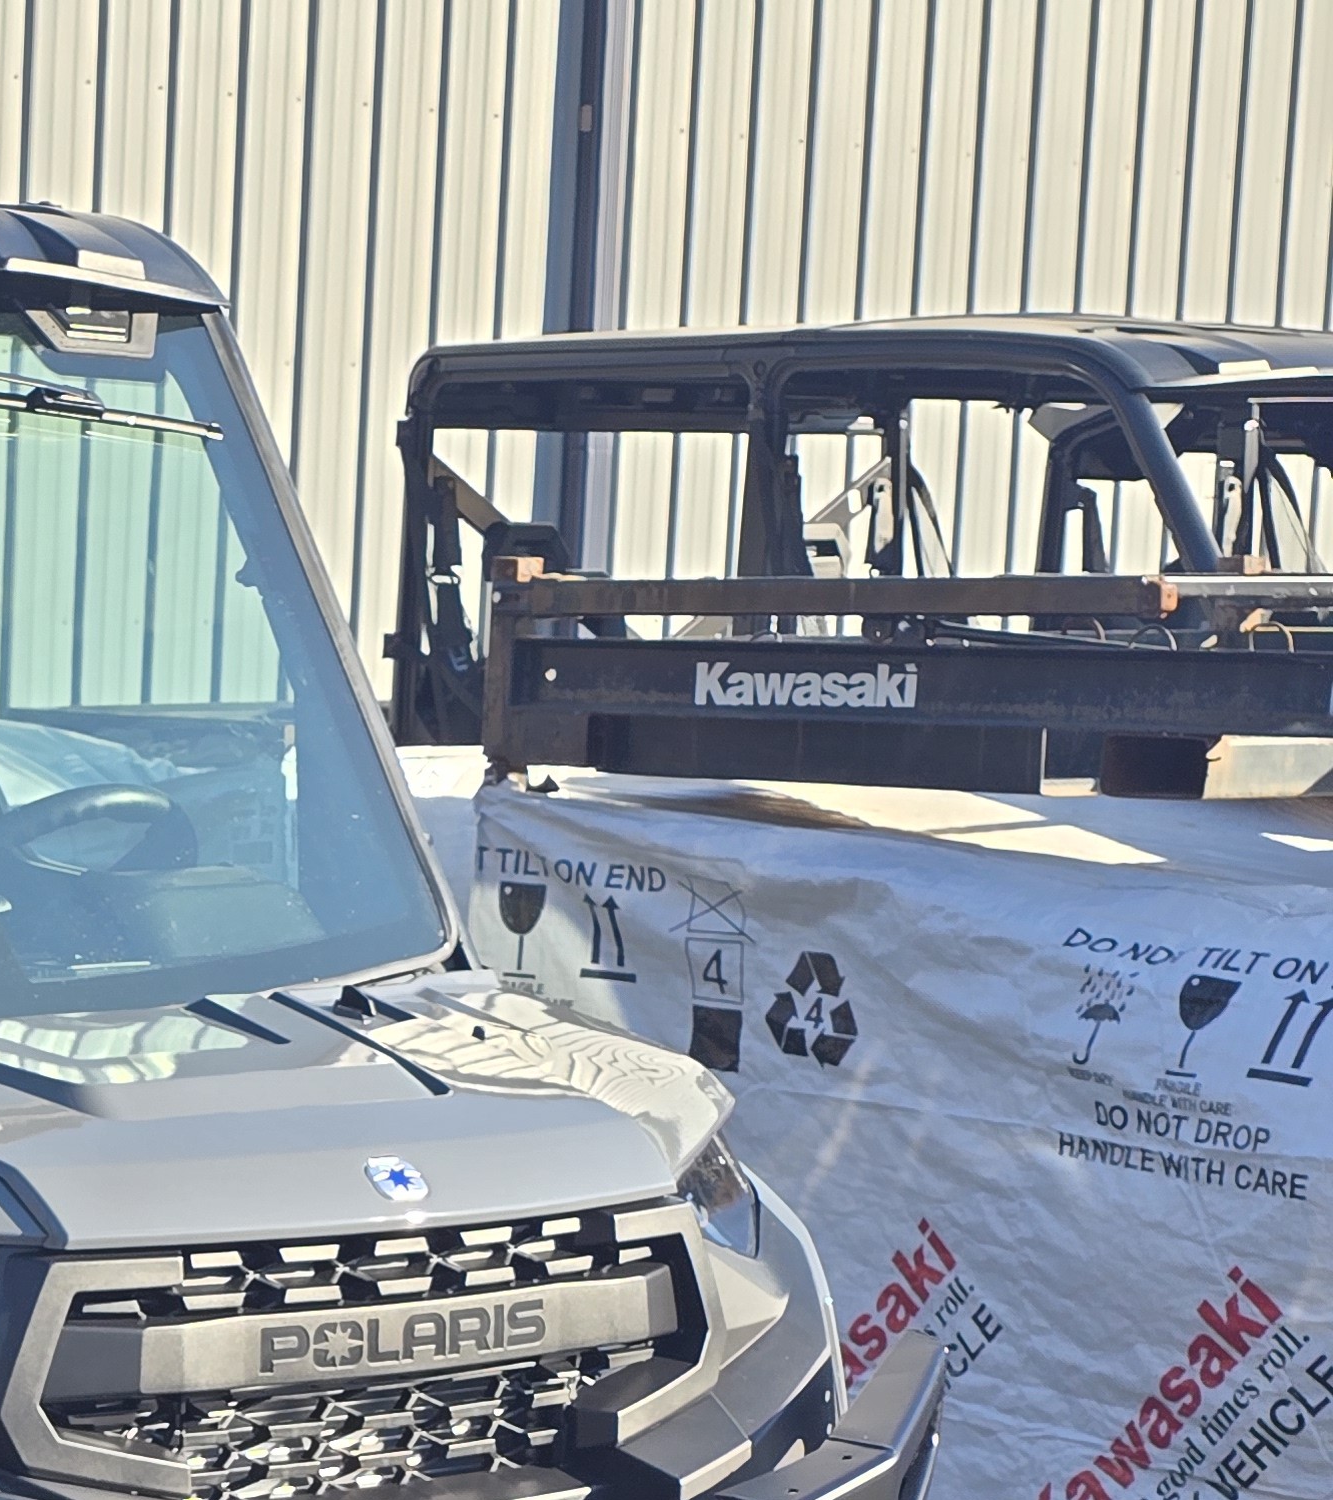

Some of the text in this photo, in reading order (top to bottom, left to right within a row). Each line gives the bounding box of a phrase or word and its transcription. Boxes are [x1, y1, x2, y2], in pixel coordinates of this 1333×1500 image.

[694, 662, 918, 707] Kawasaki
[554, 859, 597, 887] ON
[605, 864, 667, 892] END
[703, 949, 727, 994] 4
[1063, 927, 1330, 985] DO NO TILT ON
[805, 997, 824, 1030] 4
[1094, 1101, 1270, 1152] DO NOT DROP
[1058, 1131, 1309, 1200] HANDLE WITH CARE
[935, 1277, 975, 1327] roll.
[258, 1298, 546, 1376] POLARIS
[944, 1303, 1003, 1390] CLE
[1200, 1378, 1260, 1446] times
[1258, 1325, 1310, 1383] roll.
